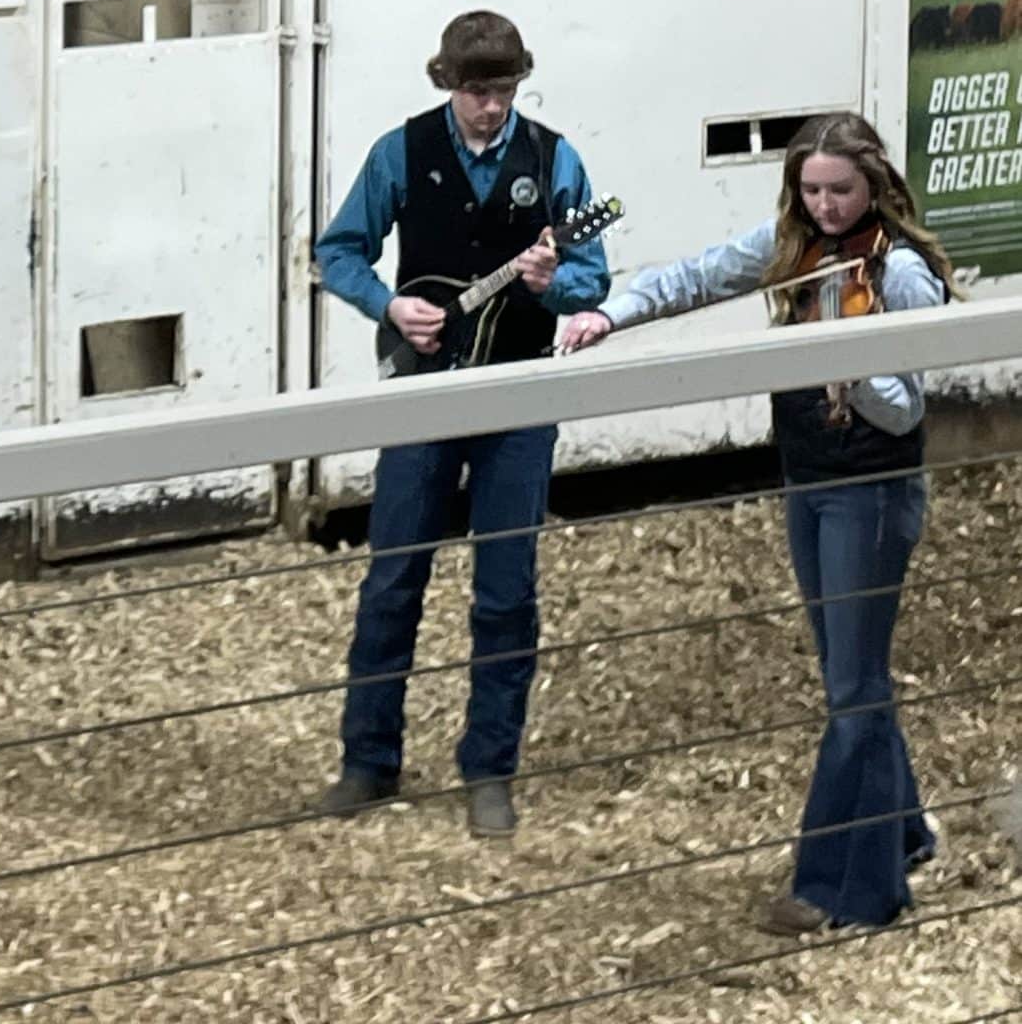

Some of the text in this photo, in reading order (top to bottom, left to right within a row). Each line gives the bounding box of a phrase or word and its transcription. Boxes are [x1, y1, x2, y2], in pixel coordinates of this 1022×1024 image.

[928, 71, 1010, 114] BIGGER
[927, 110, 1011, 154] BETTER
[926, 147, 1022, 195] GREATER
